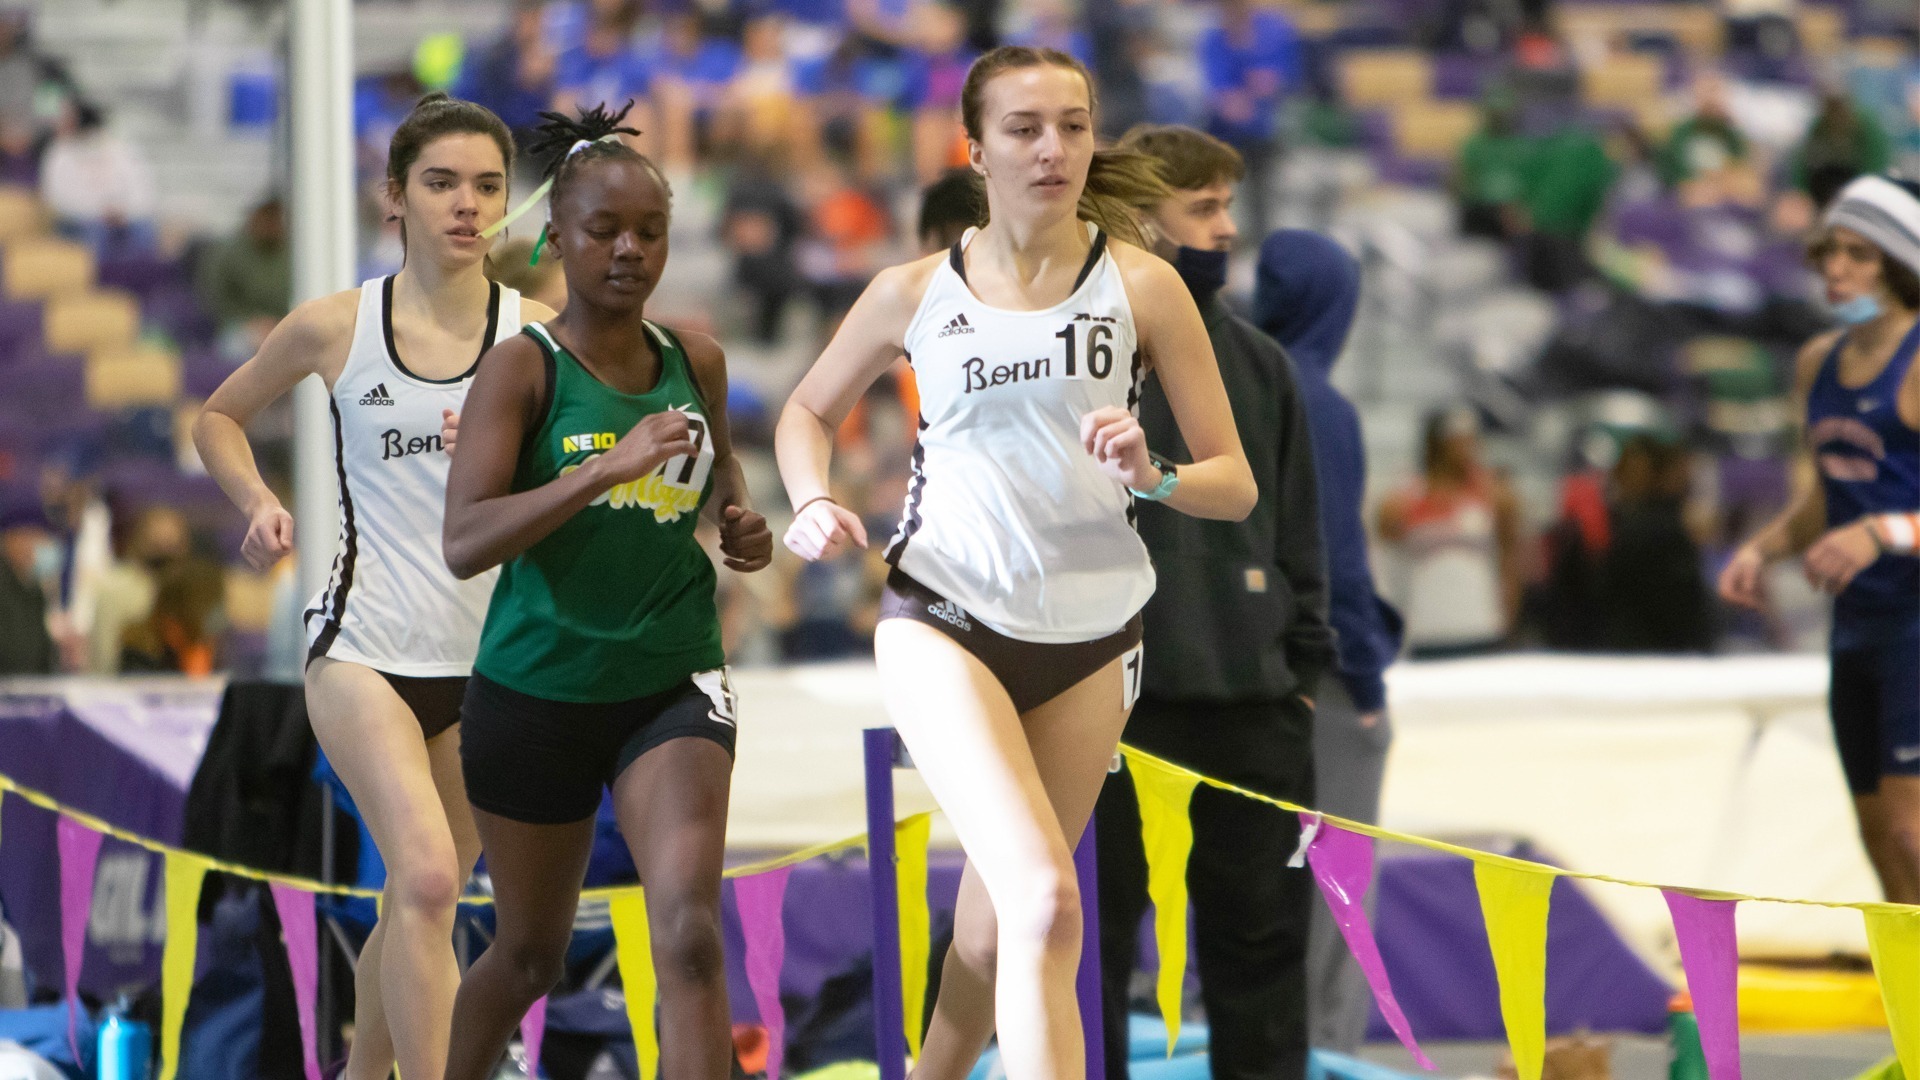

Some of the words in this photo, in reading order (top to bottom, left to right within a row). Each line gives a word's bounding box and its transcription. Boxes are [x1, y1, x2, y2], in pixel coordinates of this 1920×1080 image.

[1055, 323, 1113, 380] 16
[359, 397, 395, 406] adidas
[927, 604, 972, 632] adidas
